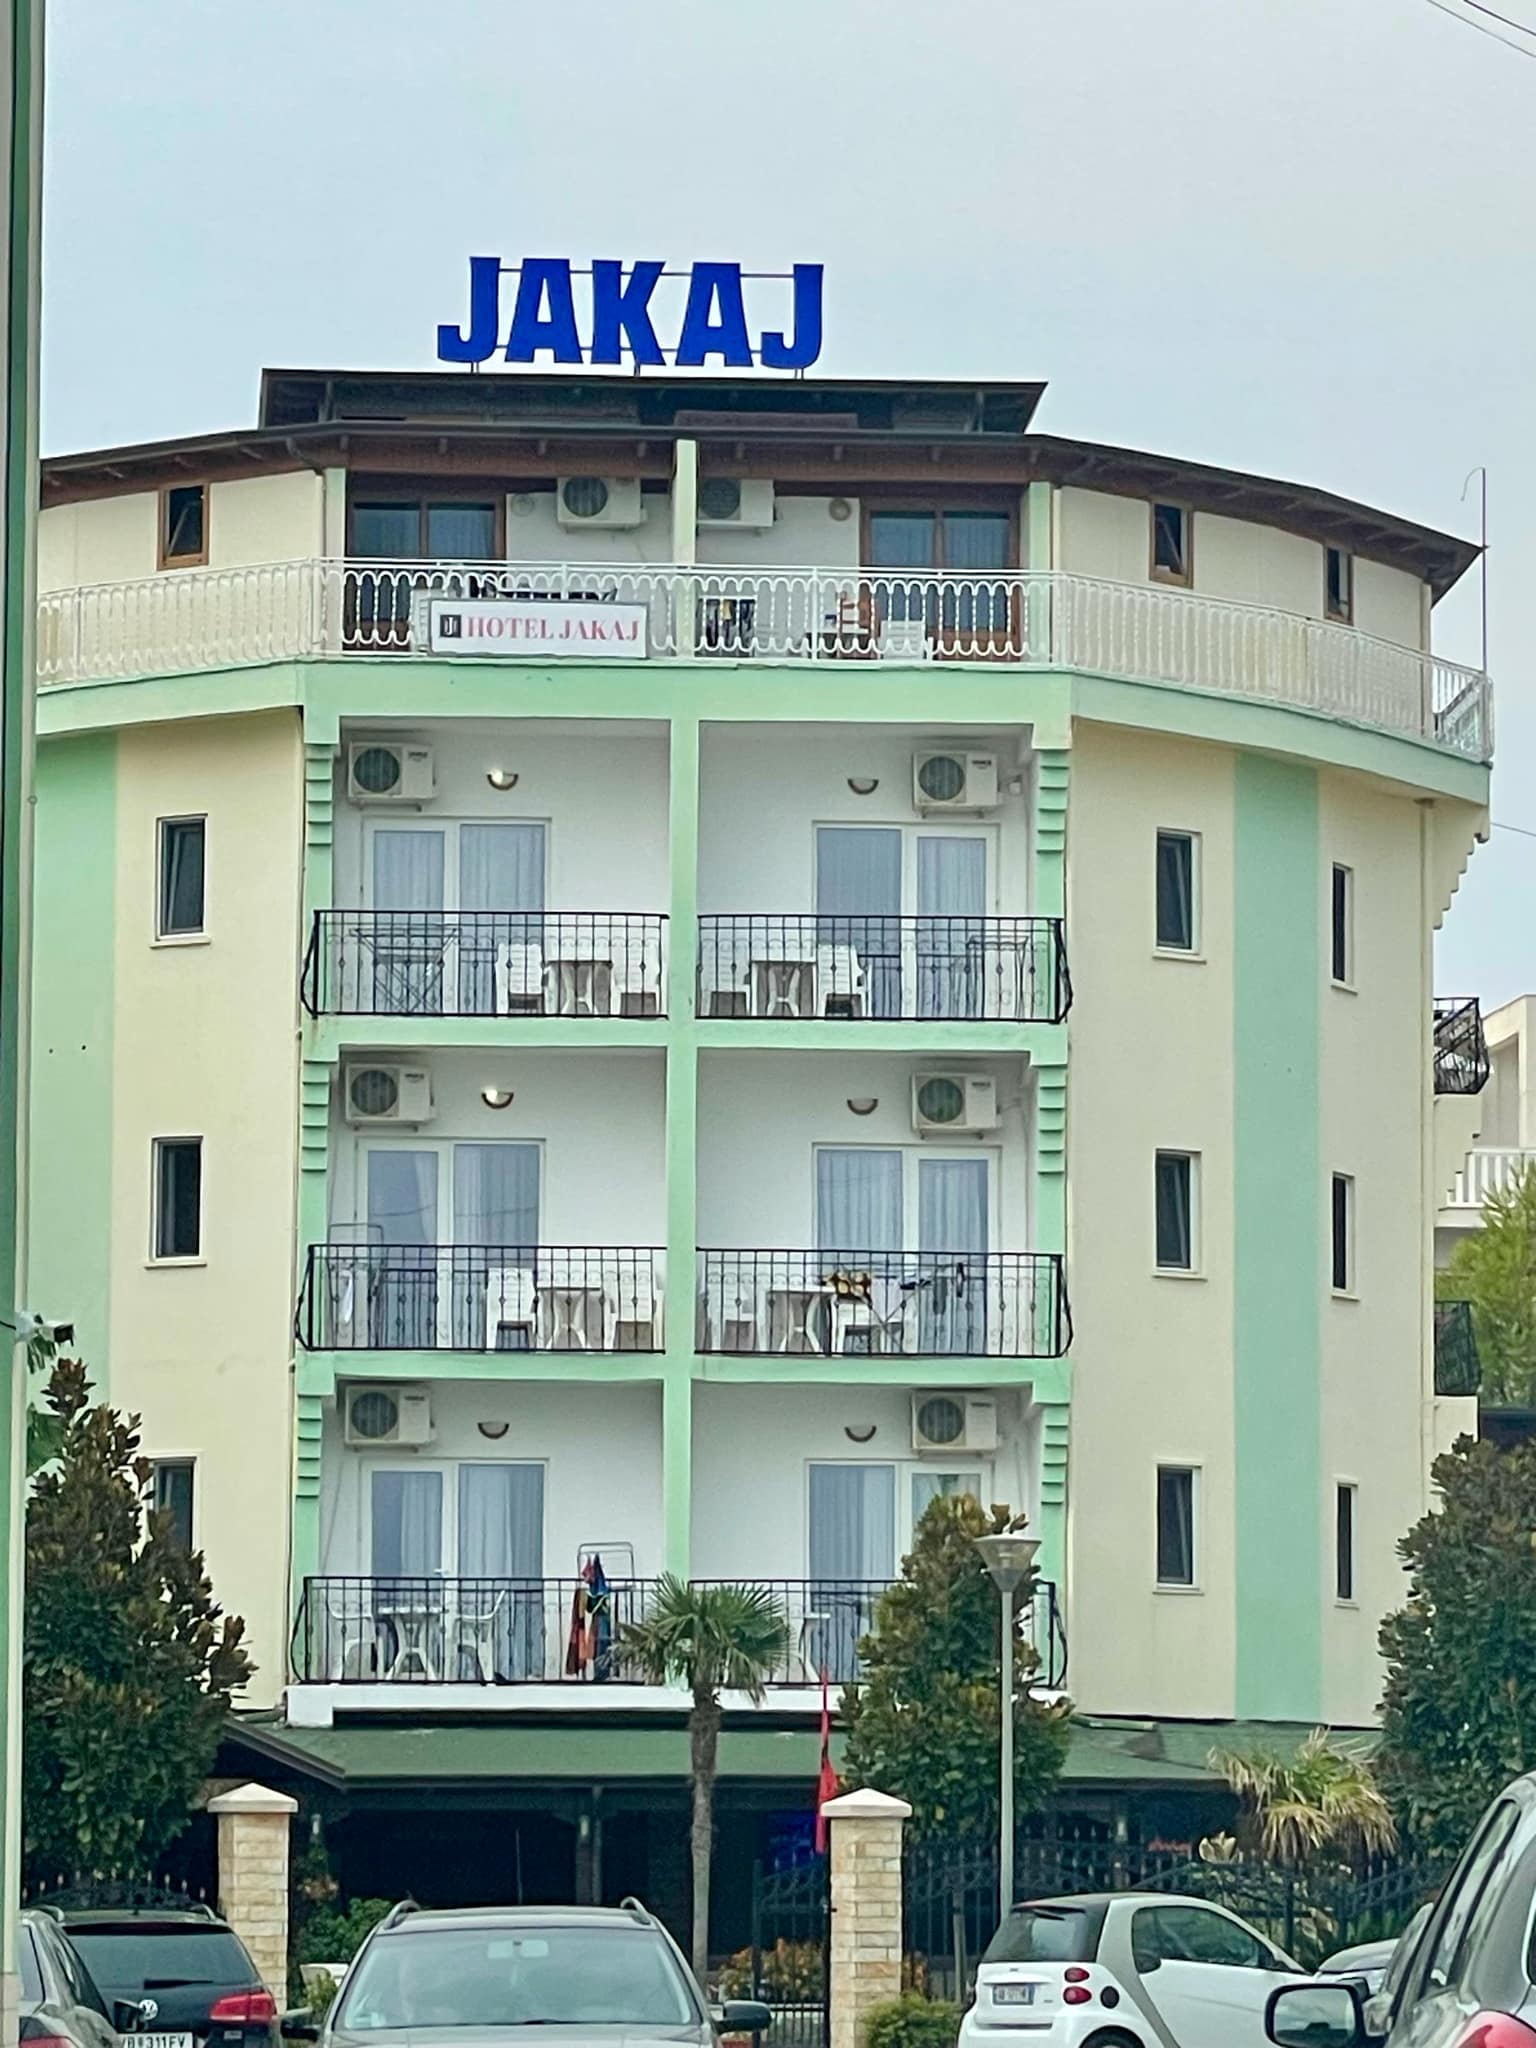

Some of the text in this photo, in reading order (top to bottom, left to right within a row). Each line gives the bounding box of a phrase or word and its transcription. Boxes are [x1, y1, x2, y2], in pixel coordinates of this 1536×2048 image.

[437, 257, 824, 369] JAKAJ
[467, 616, 554, 639] HOTEL
[558, 619, 639, 641] JAKAJ
